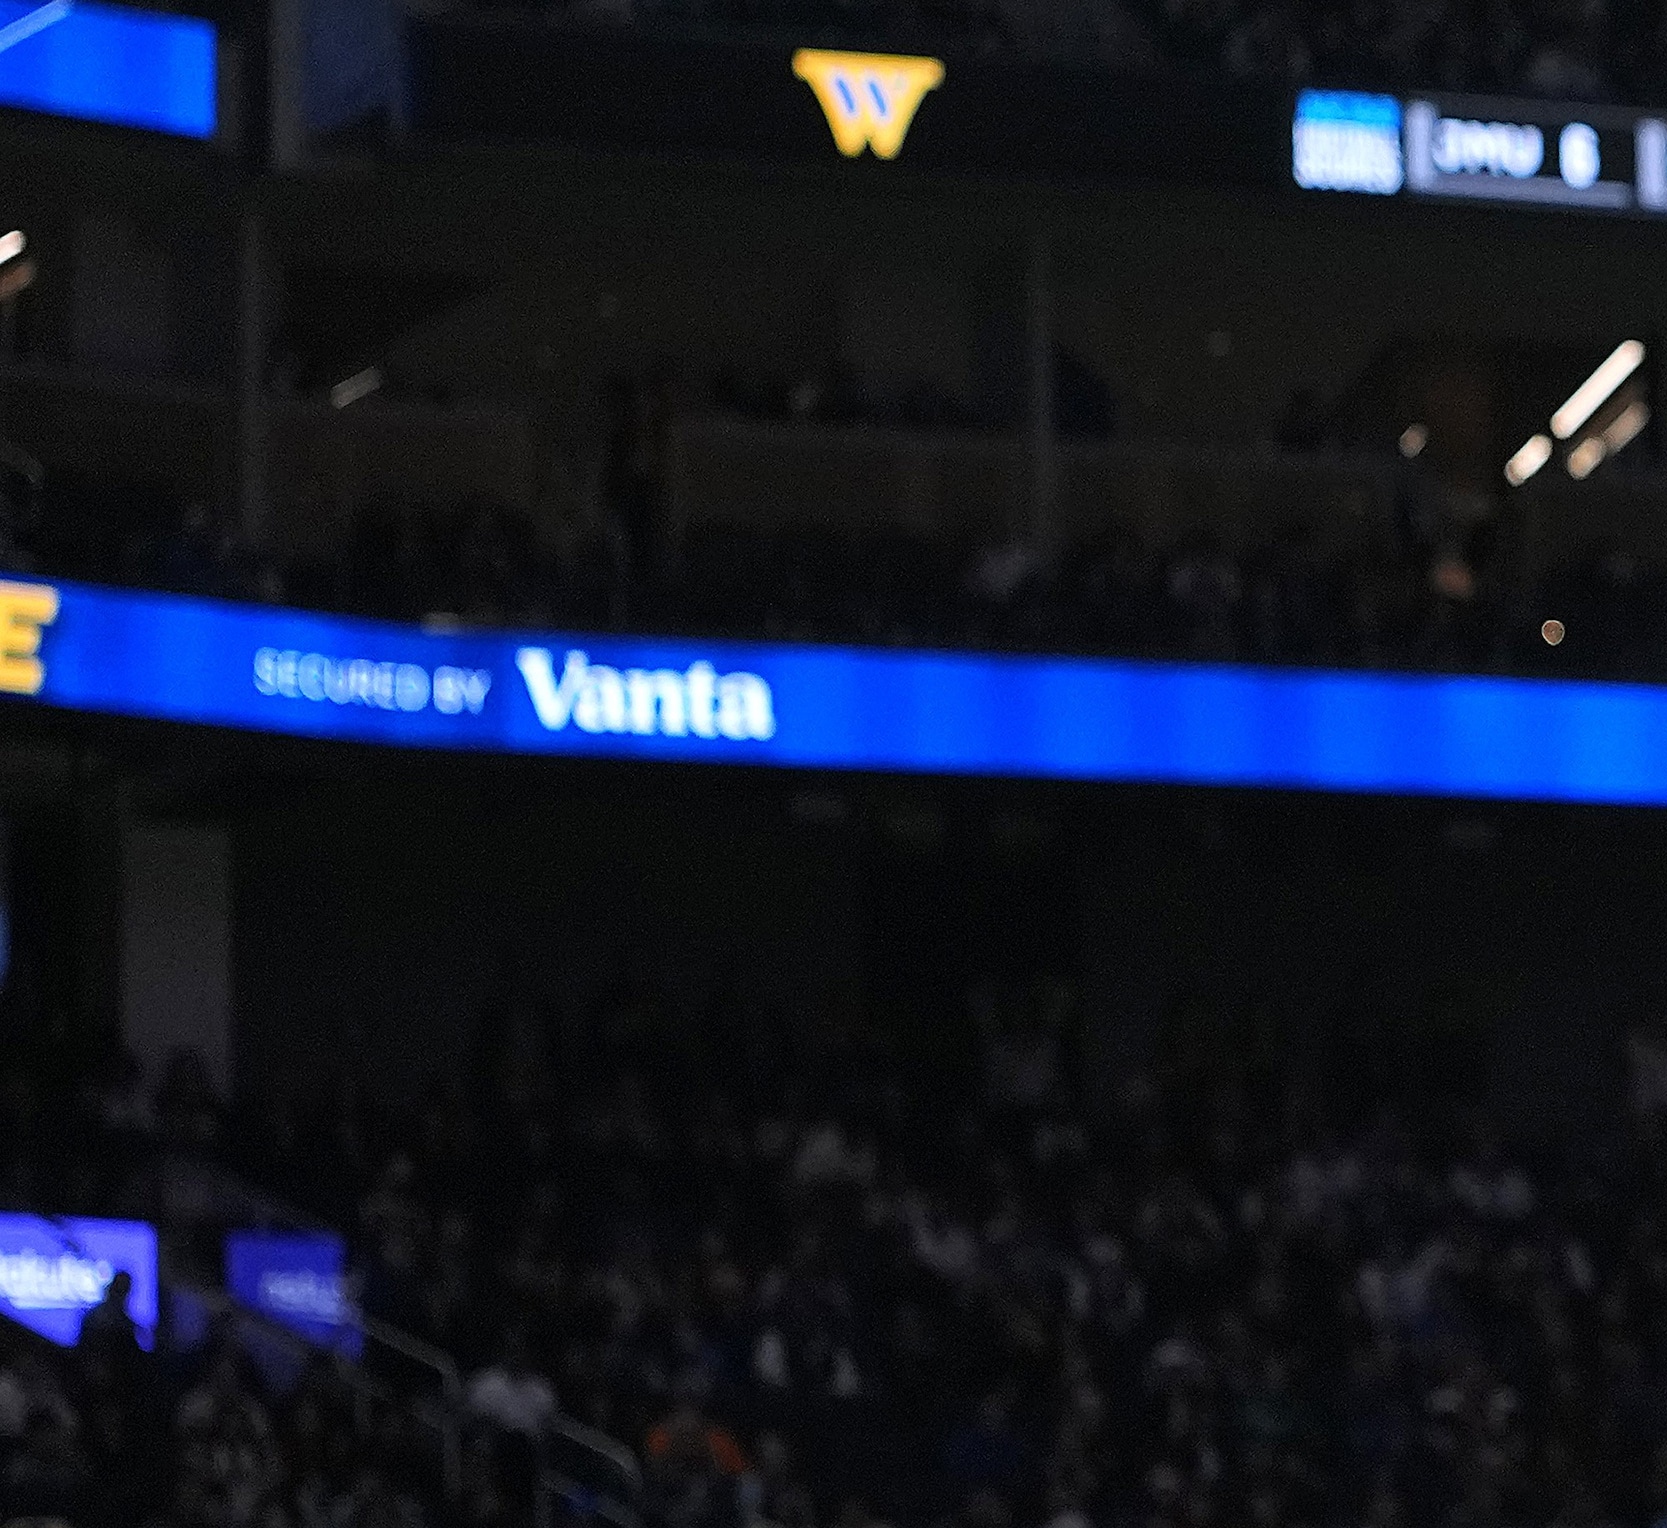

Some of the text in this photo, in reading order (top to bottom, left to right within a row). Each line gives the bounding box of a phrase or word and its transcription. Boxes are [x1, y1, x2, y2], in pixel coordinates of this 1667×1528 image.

[253, 645, 777, 740] SECURED BY Vanta
